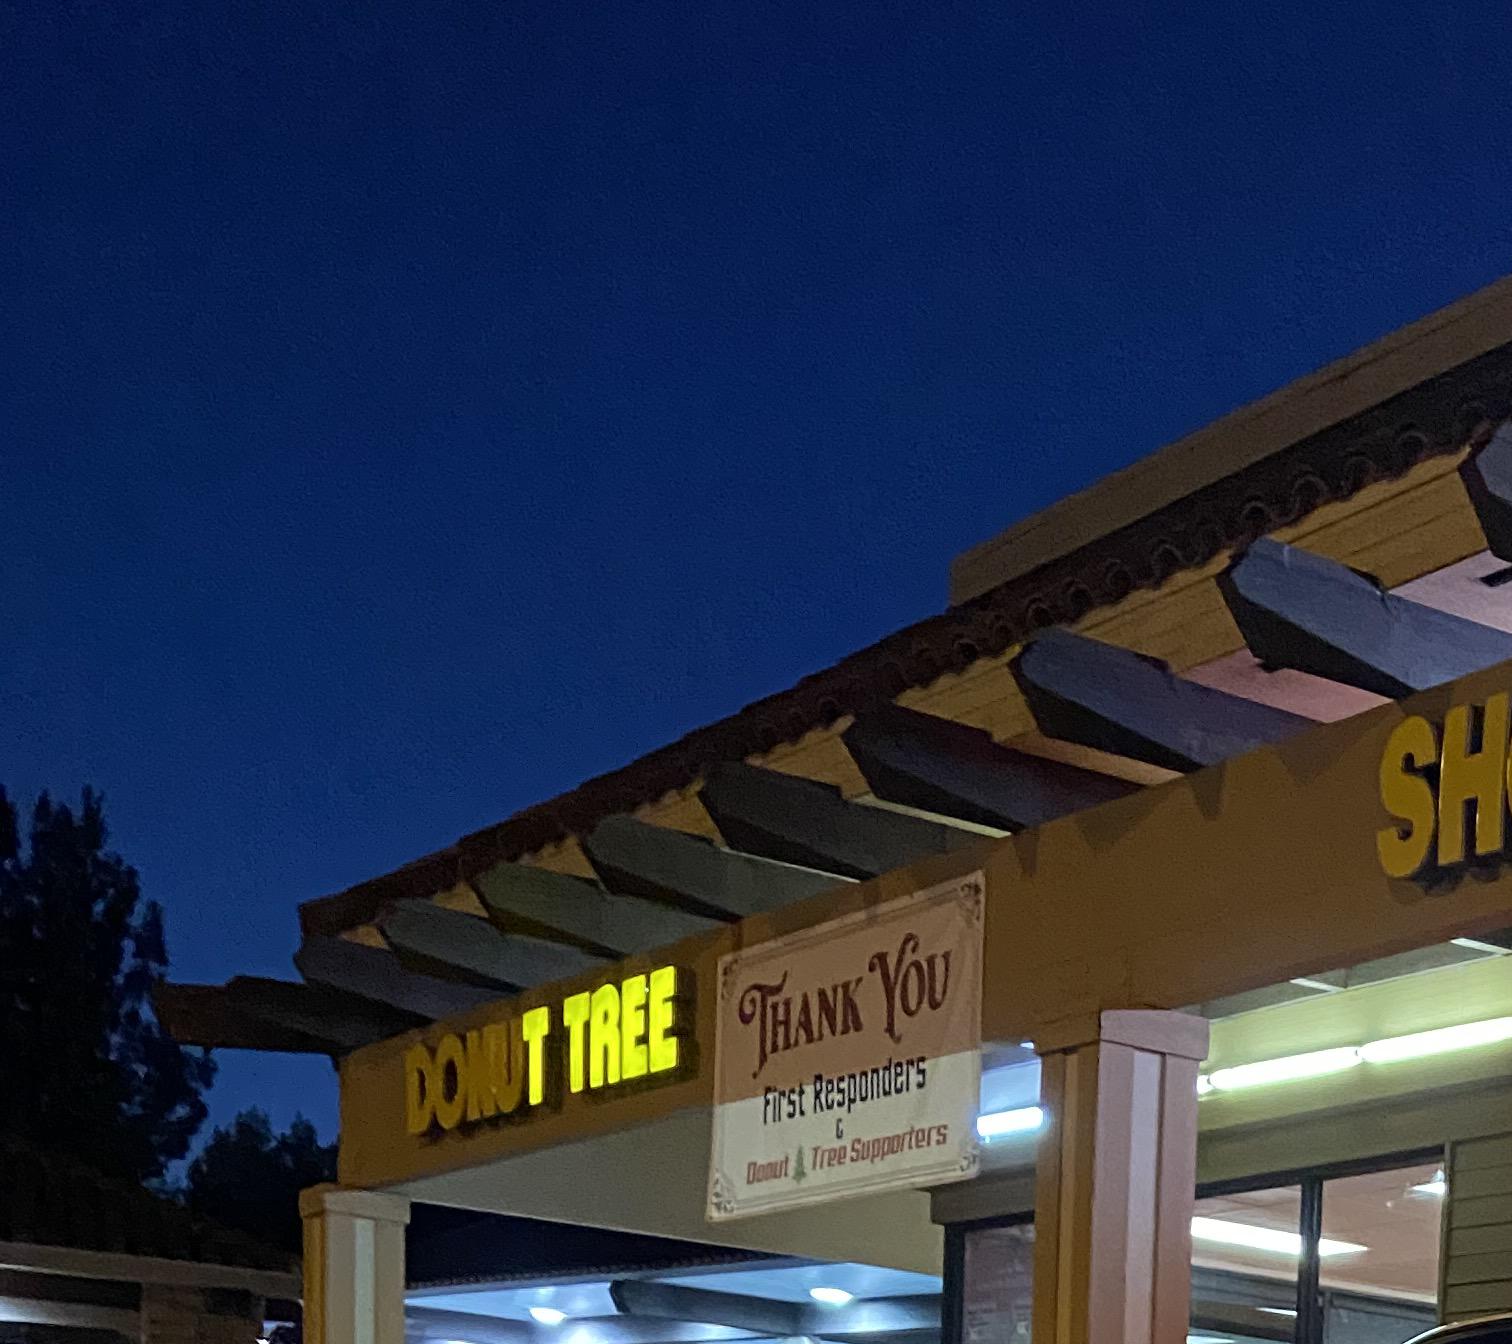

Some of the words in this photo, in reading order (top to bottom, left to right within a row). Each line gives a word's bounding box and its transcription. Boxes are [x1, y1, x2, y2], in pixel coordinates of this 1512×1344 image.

[404, 1006, 549, 1133] DONUT
[563, 965, 679, 1094] TREE
[738, 970, 864, 1079] THANK
[868, 932, 952, 1044] YOU
[763, 1082, 806, 1125] First
[813, 1056, 928, 1114] Responders
[746, 1156, 790, 1185] Donut
[811, 1145, 848, 1171] Tree
[850, 1123, 949, 1164] Supporters
